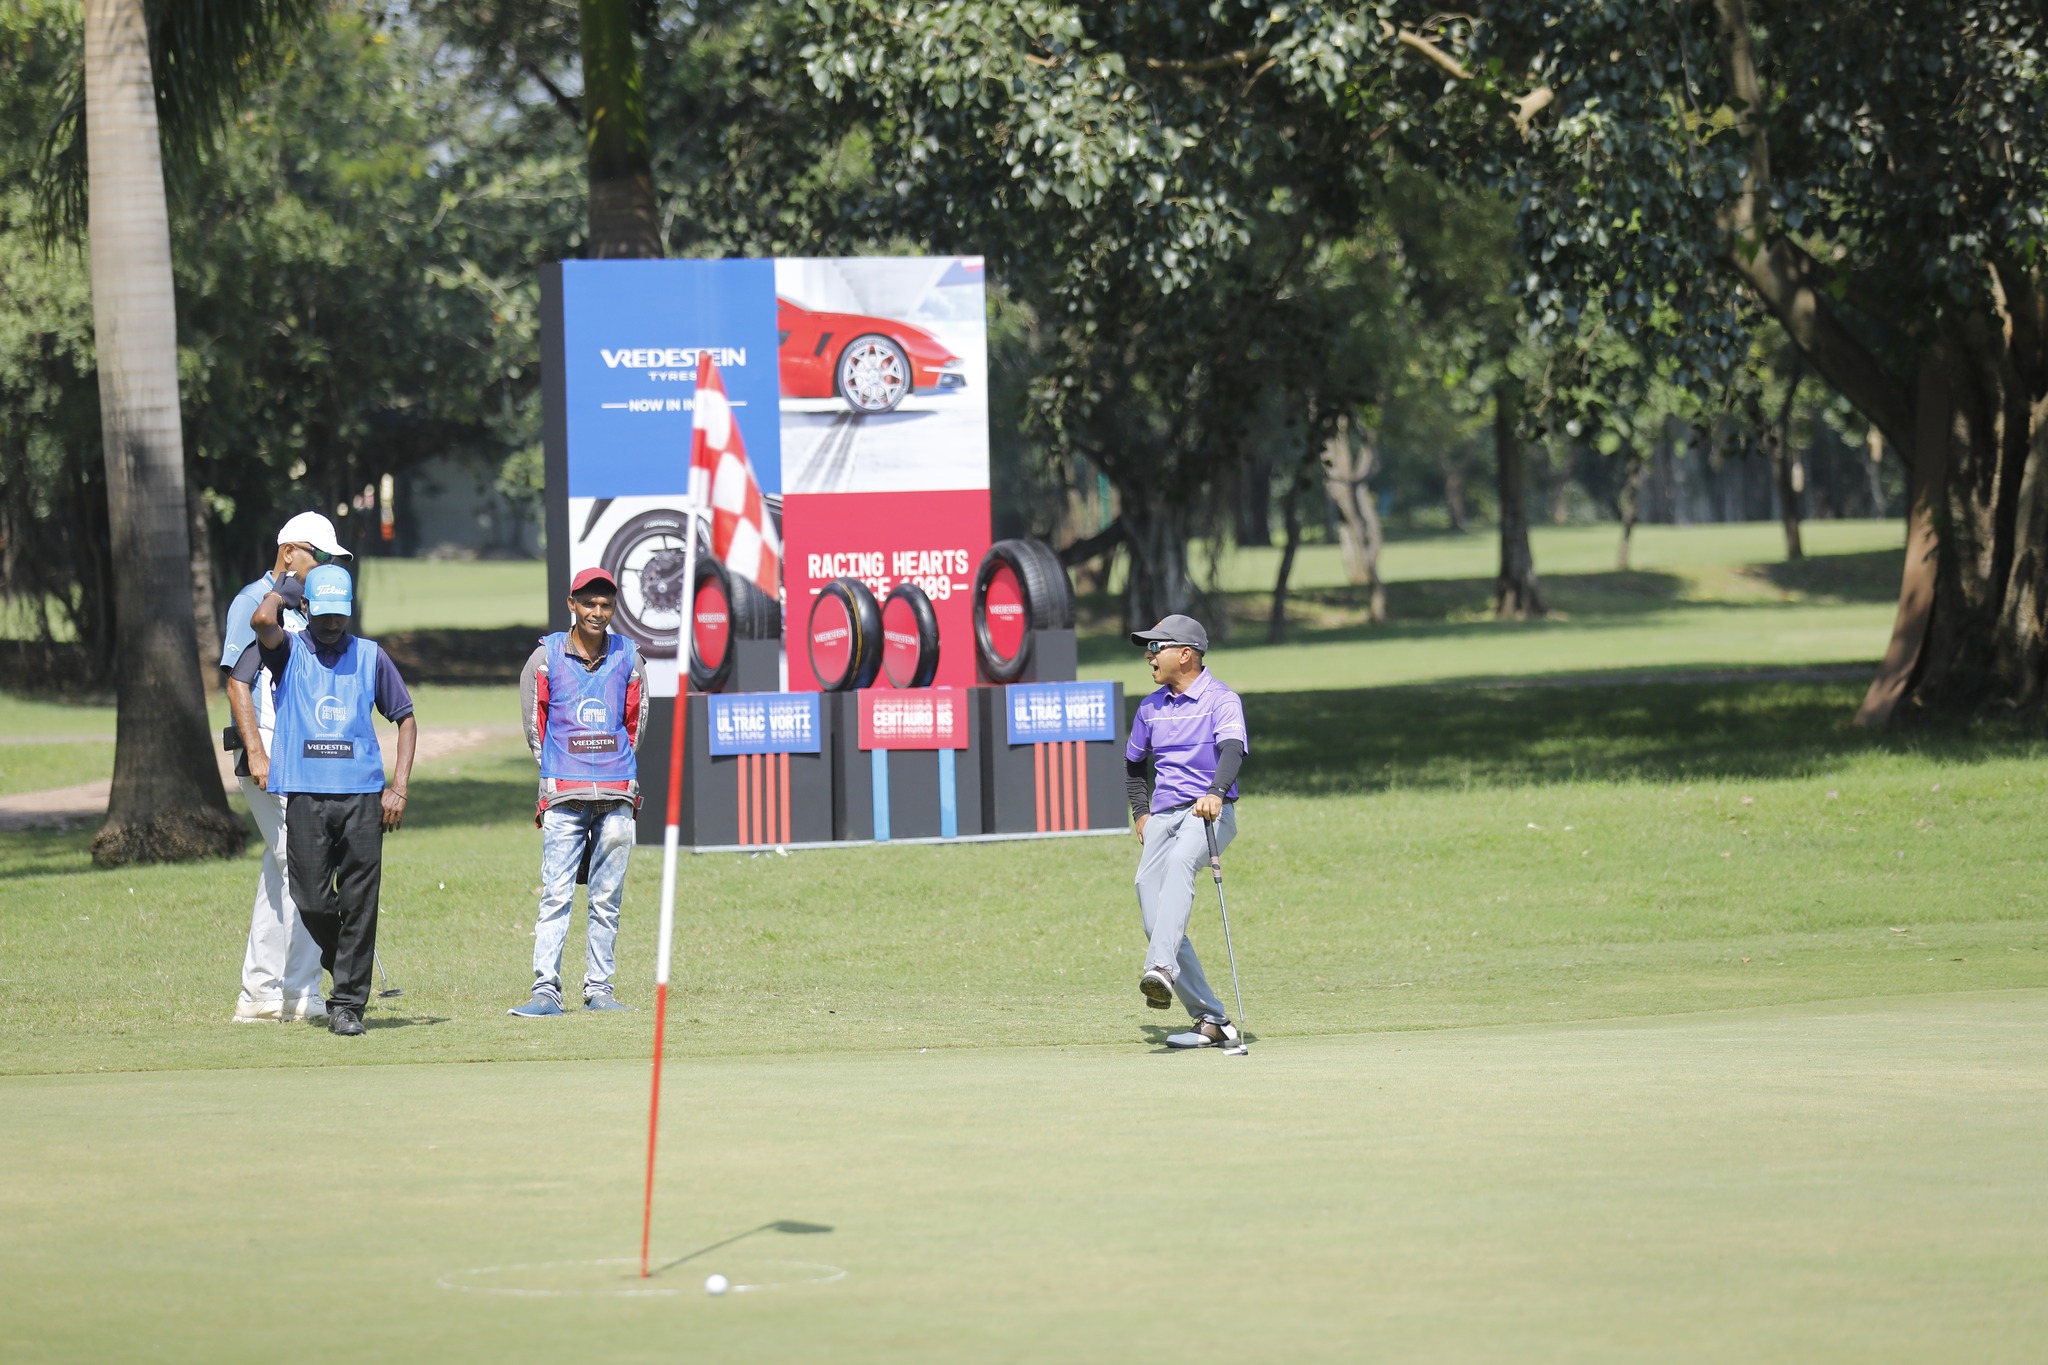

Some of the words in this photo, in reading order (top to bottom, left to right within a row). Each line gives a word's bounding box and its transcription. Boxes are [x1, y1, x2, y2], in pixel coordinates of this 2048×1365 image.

[600, 348, 747, 369] VREDESTEIN
[648, 371, 698, 381] TYRES
[628, 399, 664, 412] NOW
[665, 399, 681, 412] IN
[808, 551, 885, 579] RACING
[892, 549, 969, 576] HEARTS
[873, 711, 934, 727] CENTAURO
[936, 711, 954, 726] NS
[1014, 704, 1062, 721] ULTRAC
[1065, 702, 1106, 719] VORTI
[716, 716, 766, 733] ULTRAC
[769, 714, 811, 731] VORTI
